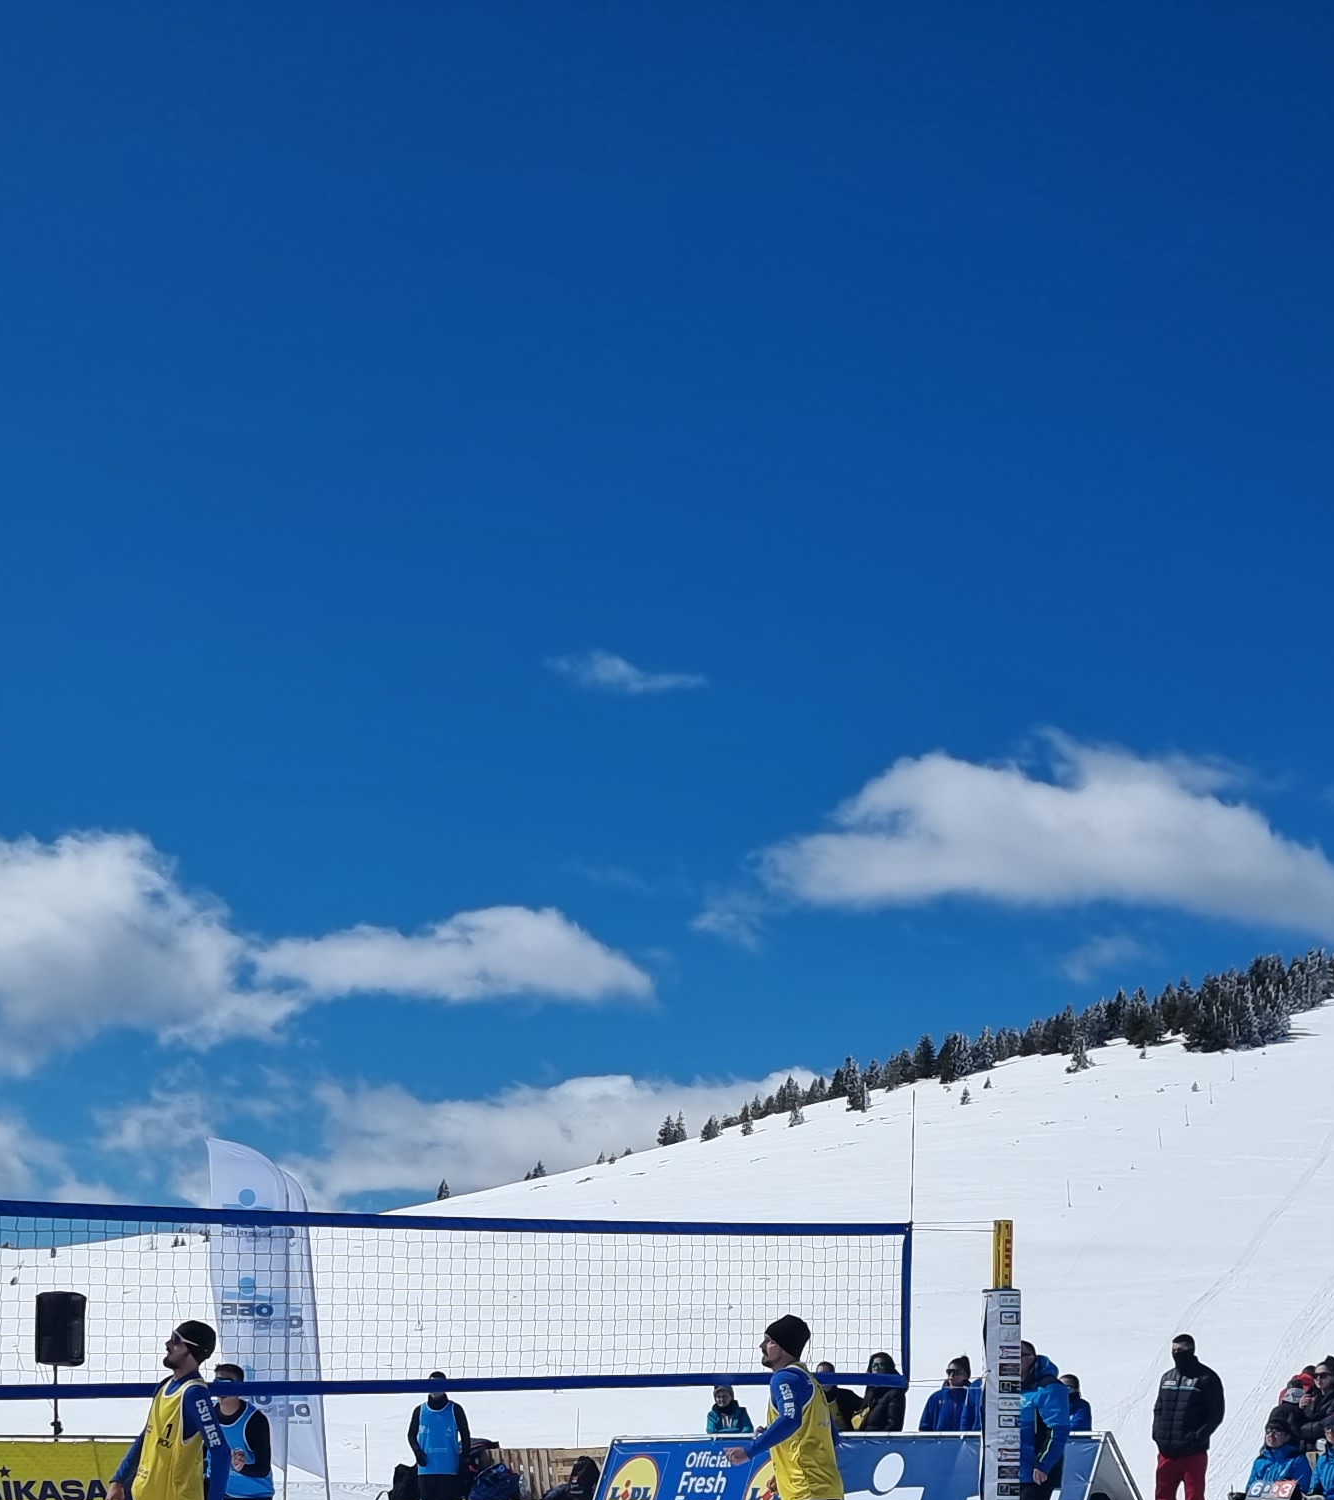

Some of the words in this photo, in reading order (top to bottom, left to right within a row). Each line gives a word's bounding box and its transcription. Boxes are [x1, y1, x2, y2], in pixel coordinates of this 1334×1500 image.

[195, 1399, 212, 1422] CSU
[166, 1424, 173, 1439] 1
[677, 1471, 727, 1494] Fresh
[1250, 1482, 1263, 1496] 6
[1278, 1483, 1292, 1497] 3
